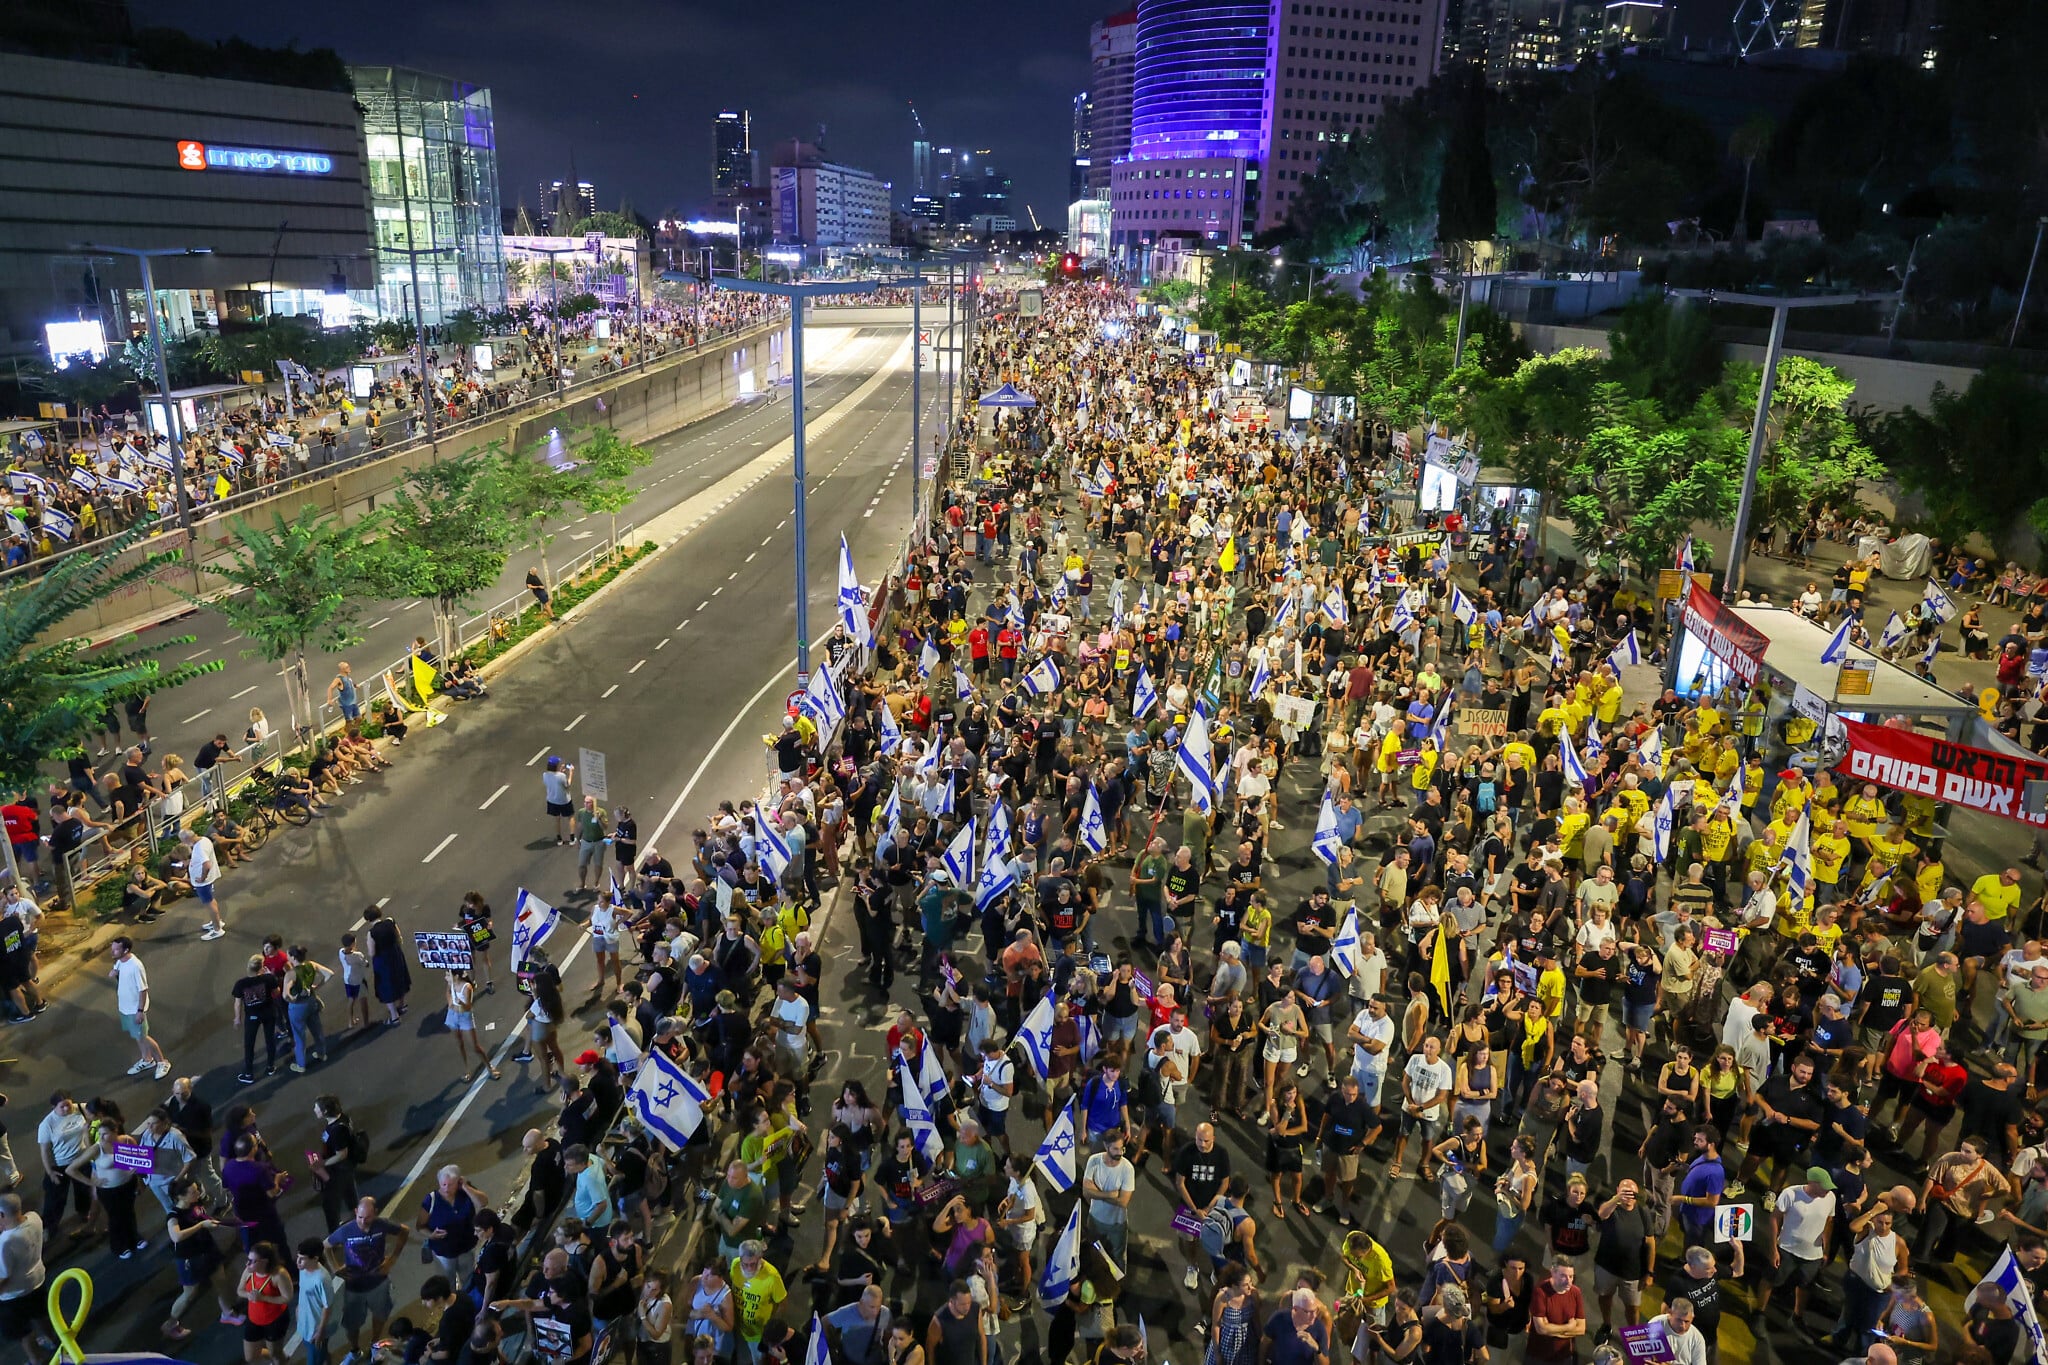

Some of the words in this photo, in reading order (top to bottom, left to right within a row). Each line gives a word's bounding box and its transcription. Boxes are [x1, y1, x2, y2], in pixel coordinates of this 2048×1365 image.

[208, 149, 331, 173] סופר-פארם
[1470, 534, 1491, 552] 75
[1711, 629, 1735, 663] אשם
[1851, 749, 1938, 795] במותם
[1931, 742, 2017, 785] הראש
[1942, 772, 2015, 815] אשם
[1630, 1341, 1663, 1355] עכשיו
